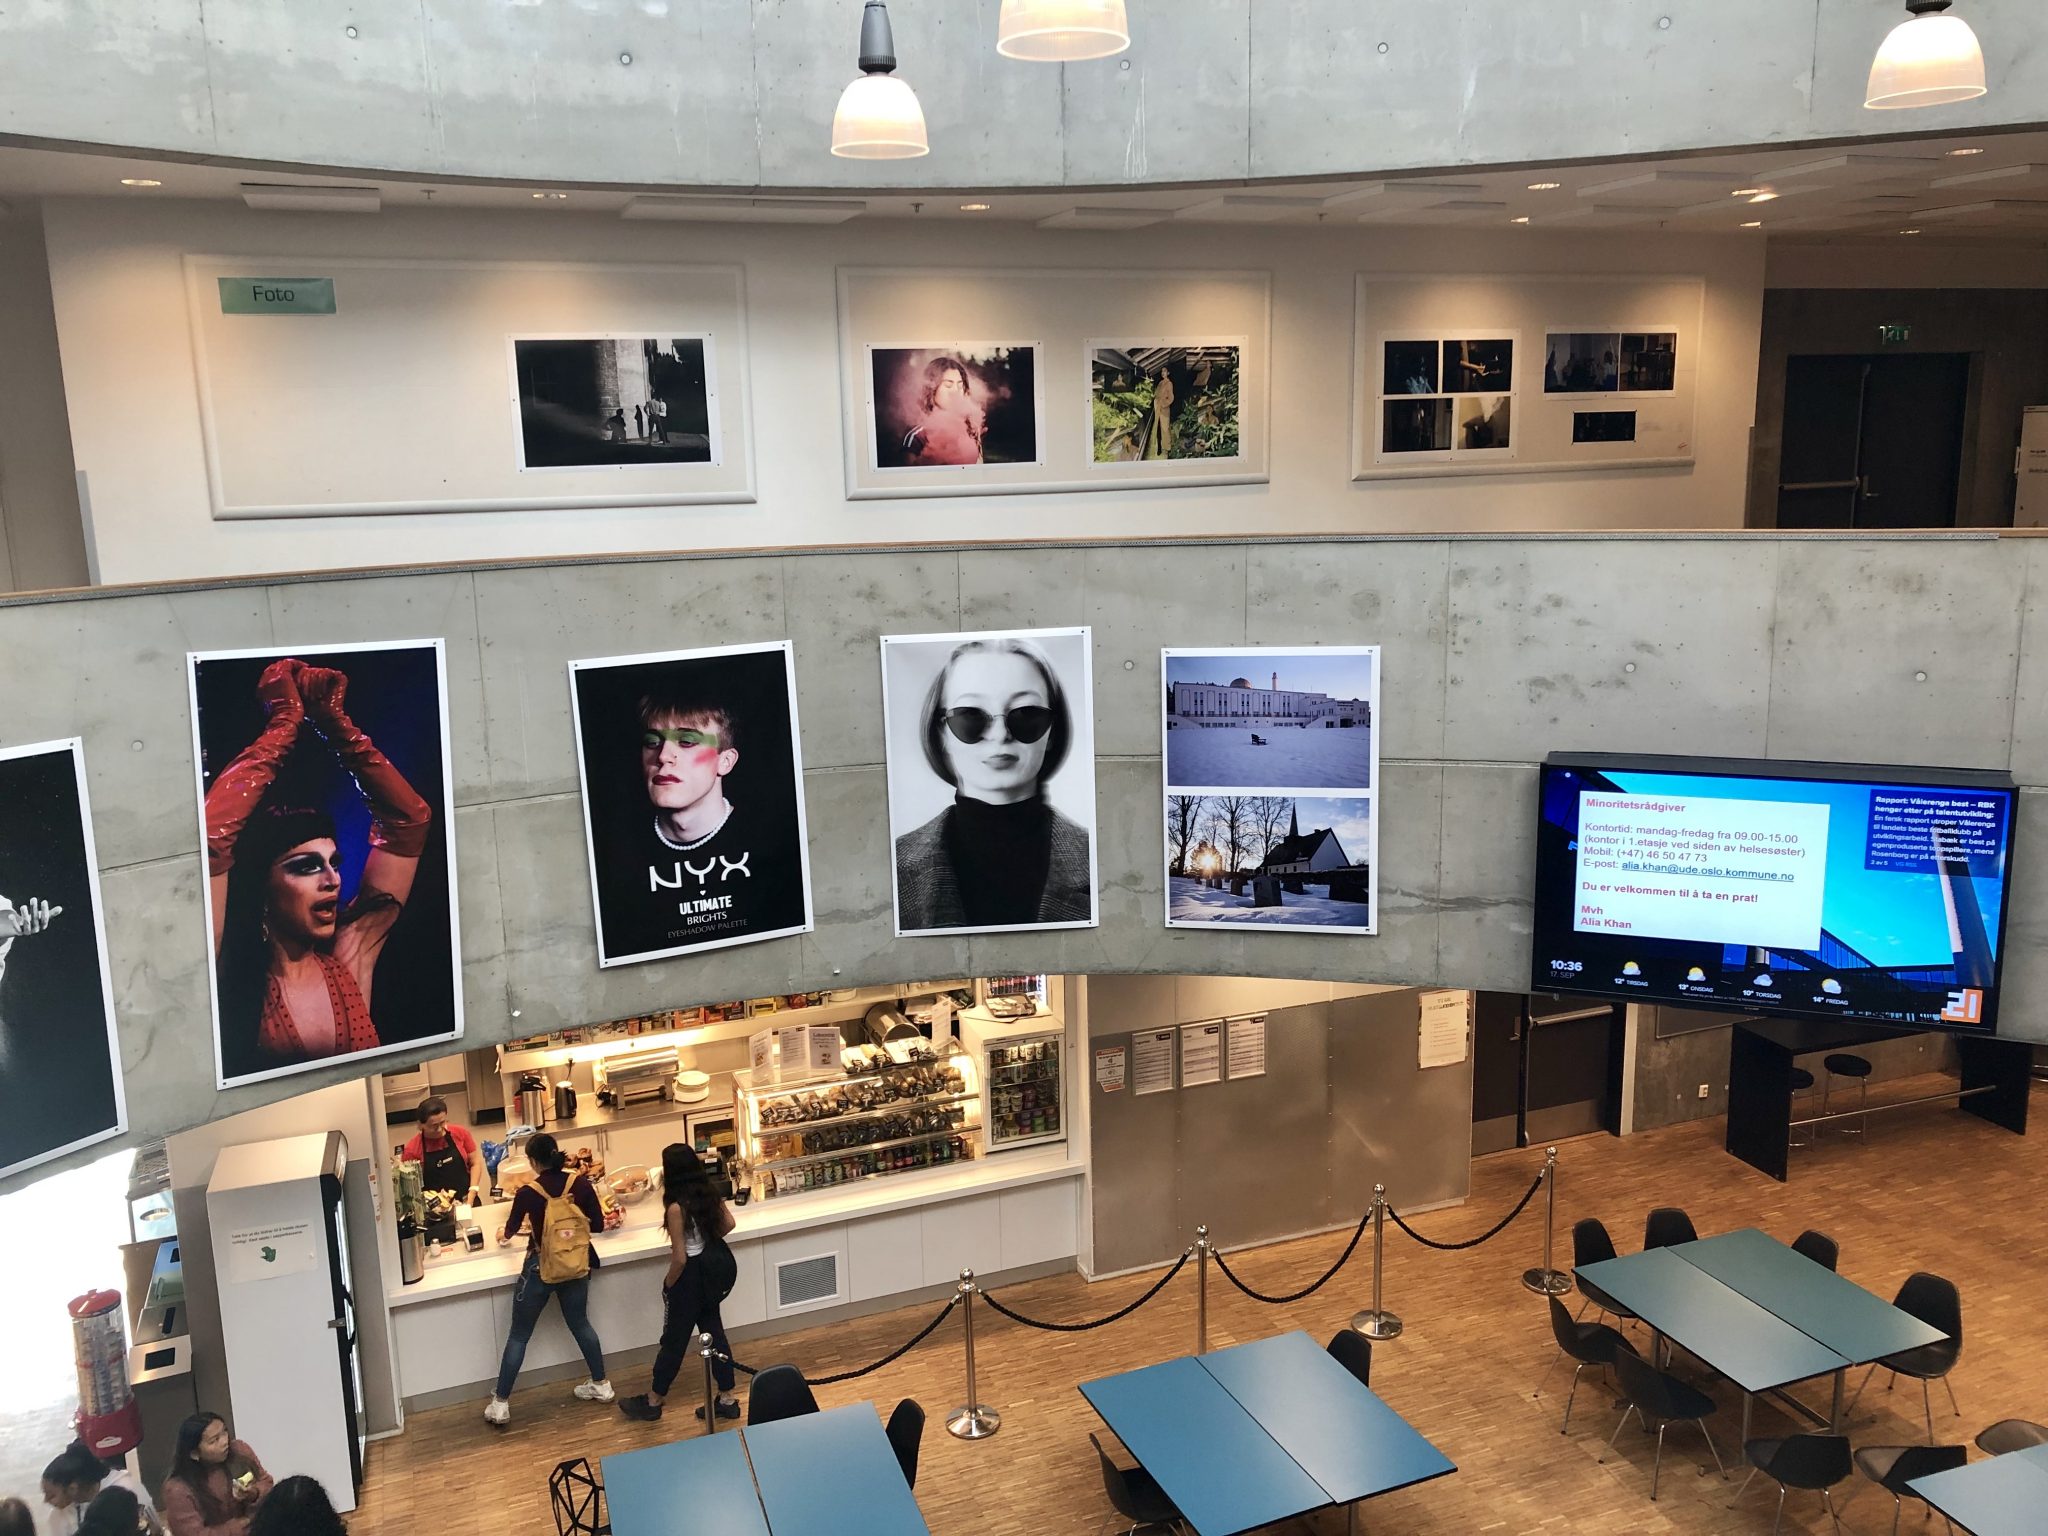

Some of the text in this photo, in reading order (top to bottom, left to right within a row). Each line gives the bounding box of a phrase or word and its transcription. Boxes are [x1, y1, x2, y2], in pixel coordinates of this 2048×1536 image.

[252, 285, 295, 302] Foto
[1586, 798, 1686, 812] Minoritetsrådgiver
[1875, 796, 1909, 805] Rapport:
[1910, 798, 1950, 808] Vålerenga
[1977, 801, 1996, 809] RBK
[1874, 805, 1902, 814] henger
[1923, 807, 1934, 815] på
[1903, 817, 1930, 825] rapport
[1958, 819, 1996, 829] Vålerenga
[1585, 823, 1798, 844] Kontortid: mandag-fredag fra 09.00-15.00
[1972, 829, 1983, 837] på
[1584, 835, 1619, 845] (kontor
[1629, 837, 1668, 849] 1.etasje
[1671, 840, 1690, 849] ved
[1693, 842, 1721, 851] siden
[1739, 844, 1806, 858] helsesøster)
[1985, 839, 1996, 847] på
[1584, 846, 1708, 862] Mobil: (+47) 46 50 47 73
[1871, 850, 1909, 860] Rosenborg
[1919, 853, 1929, 861] på
[649, 852, 751, 892] NYX
[1583, 858, 1794, 881] E-post: alia.khan@ude.oslo.kommune.no
[1582, 882, 1597, 891] Du
[1614, 885, 1676, 896] velkommen
[1679, 889, 1690, 897] til
[1692, 890, 1699, 898] å
[1702, 891, 1712, 899] ta
[1732, 894, 1758, 903] prat!
[679, 895, 733, 916] ULTIMATE
[1581, 905, 1603, 915] Mvh
[686, 911, 728, 926] BRIGHTS
[1580, 917, 1632, 929] Alia Khan
[667, 918, 748, 940] EYESHADOW PALETTE
[1550, 960, 1583, 972] 10:36
[1560, 971, 1575, 979] SEP
[1626, 979, 1649, 987] TIRSDAG
[1755, 992, 1782, 1000] TORSDAG
[1825, 998, 1848, 1006] FREDAG
